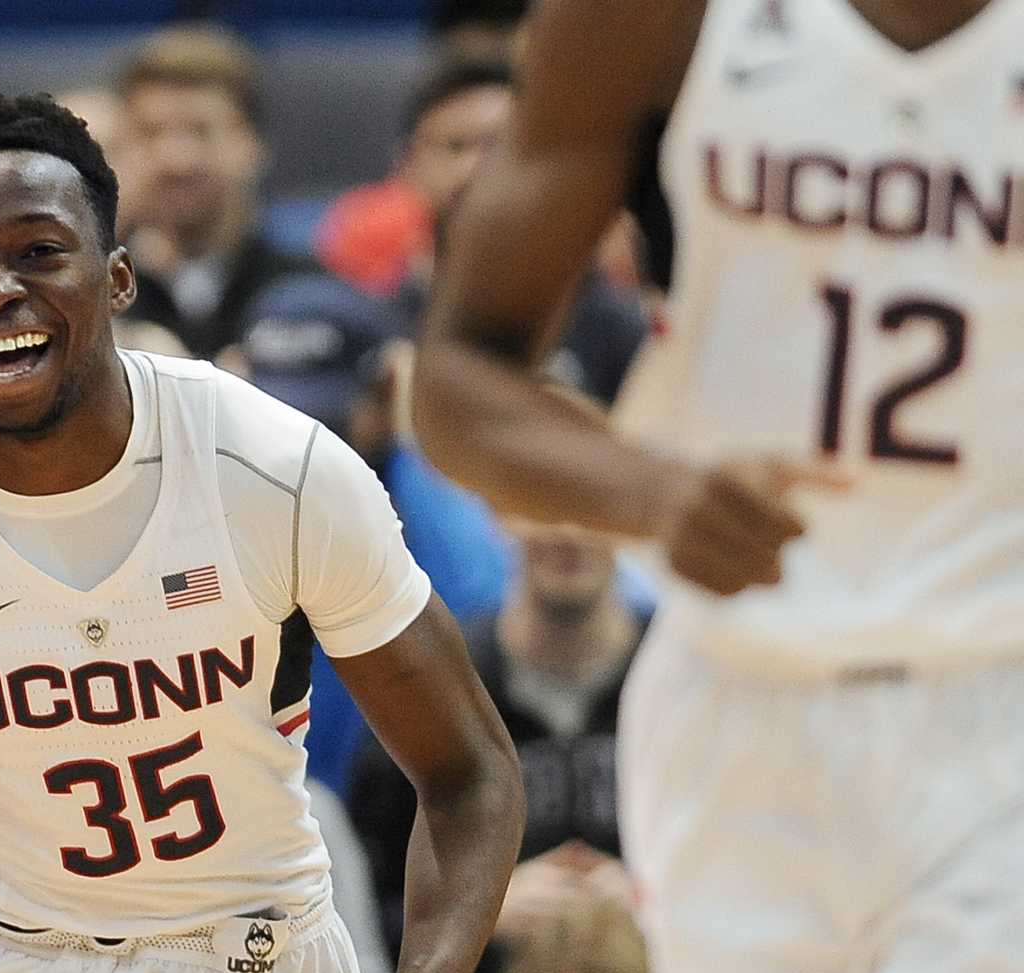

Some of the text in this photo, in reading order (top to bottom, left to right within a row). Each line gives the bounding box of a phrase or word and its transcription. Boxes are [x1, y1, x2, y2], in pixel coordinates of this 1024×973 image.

[702, 145, 1024, 246] UCON
[821, 284, 966, 464] 12
[42, 730, 226, 878] 35
